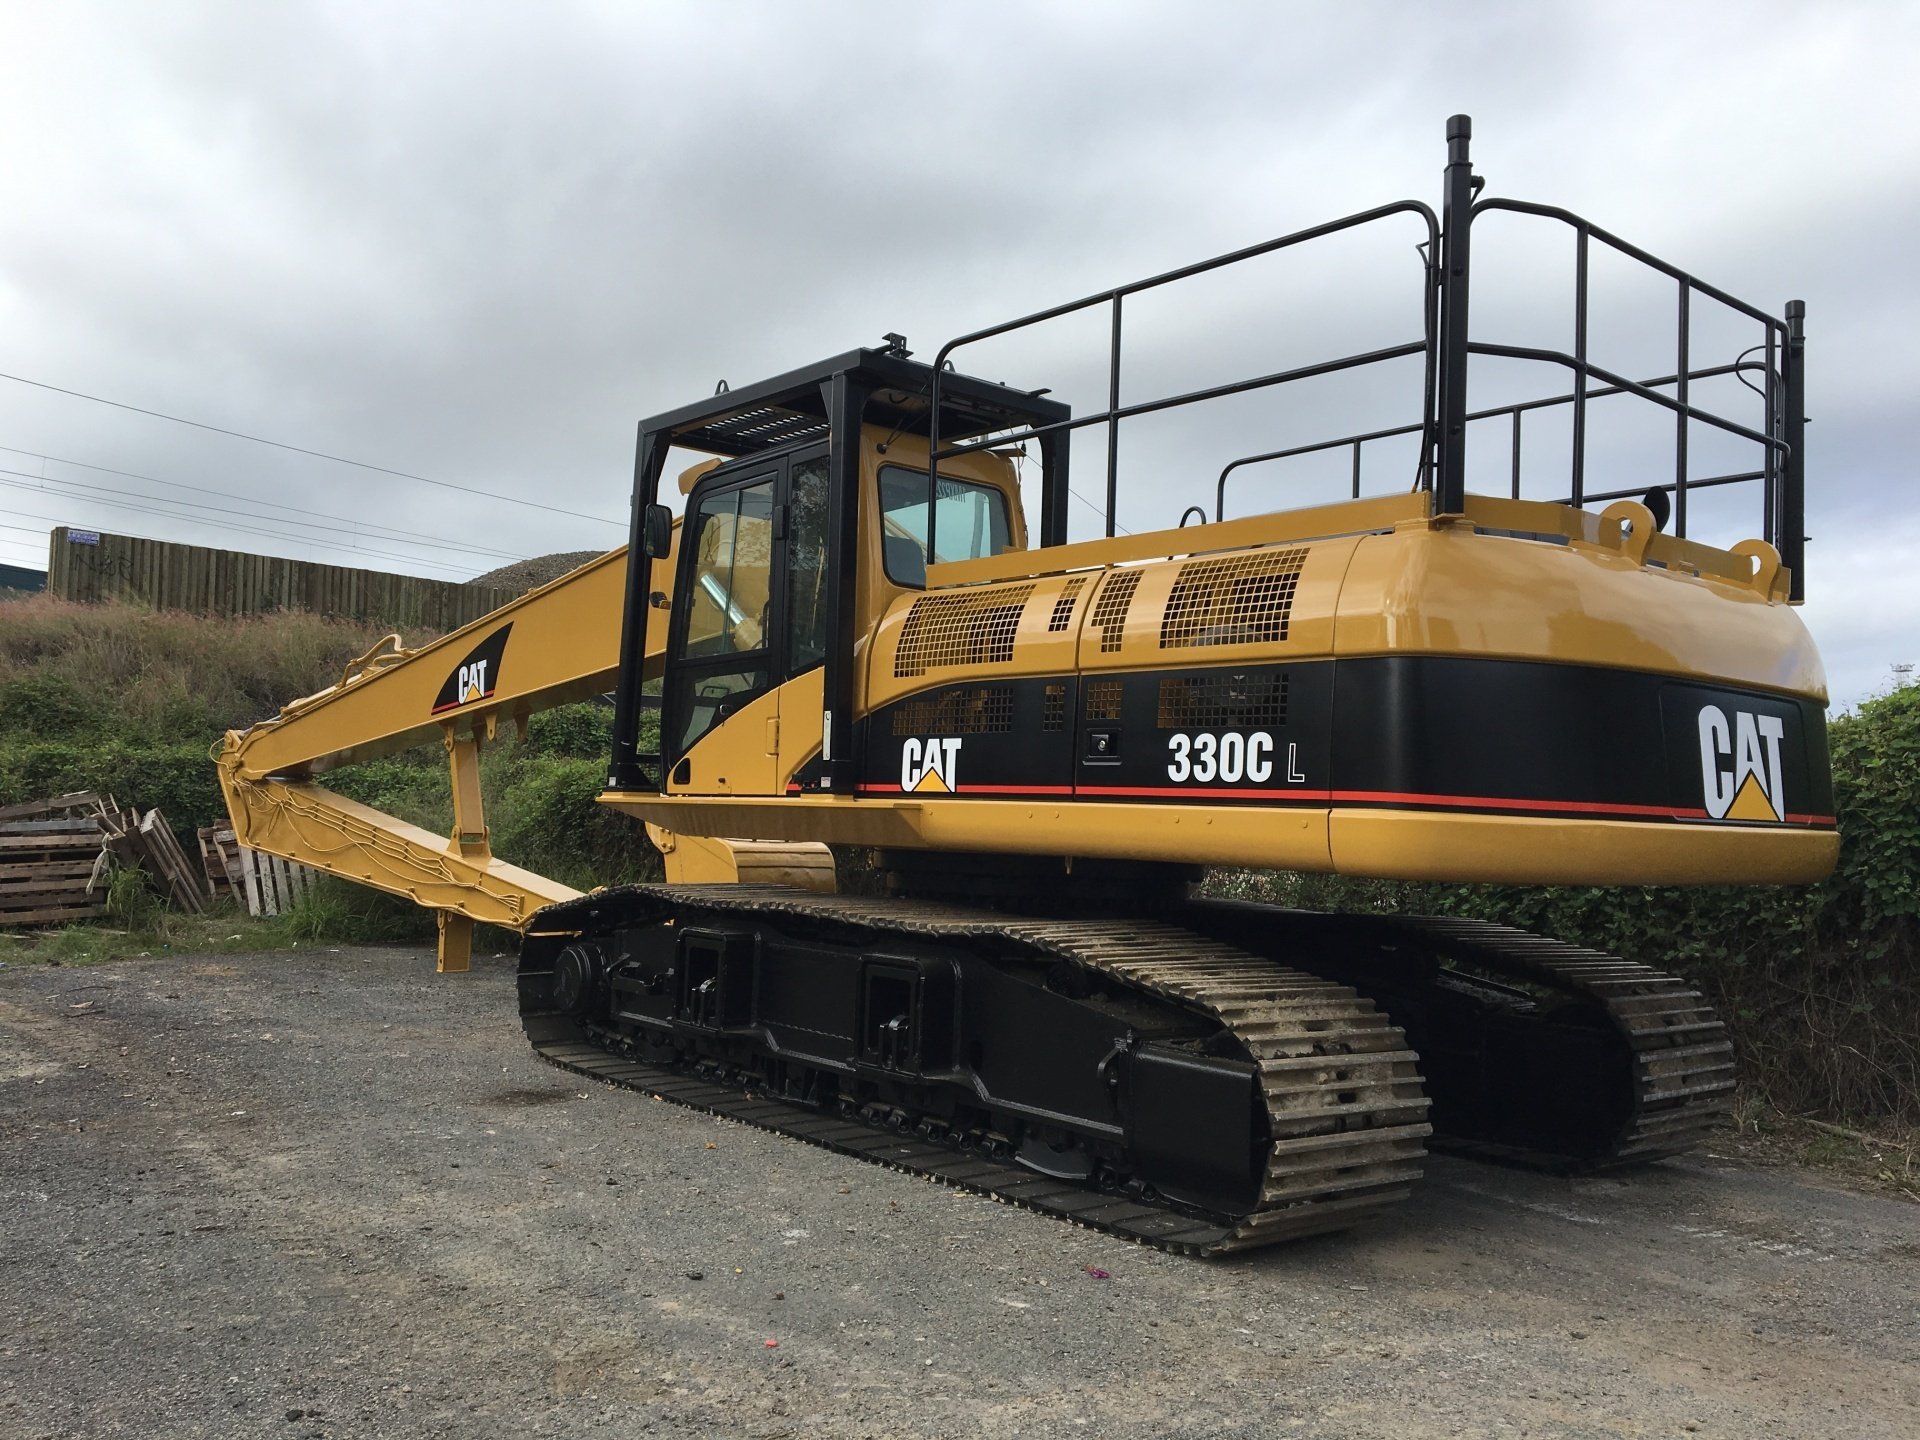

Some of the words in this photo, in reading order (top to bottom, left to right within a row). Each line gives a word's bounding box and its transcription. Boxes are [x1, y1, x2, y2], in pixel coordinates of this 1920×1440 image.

[458, 659, 487, 704] CAT
[901, 737, 962, 792] CAT
[1167, 731, 1274, 783] 330C
[1287, 742, 1305, 783] L
[1698, 704, 1785, 822] CAT
